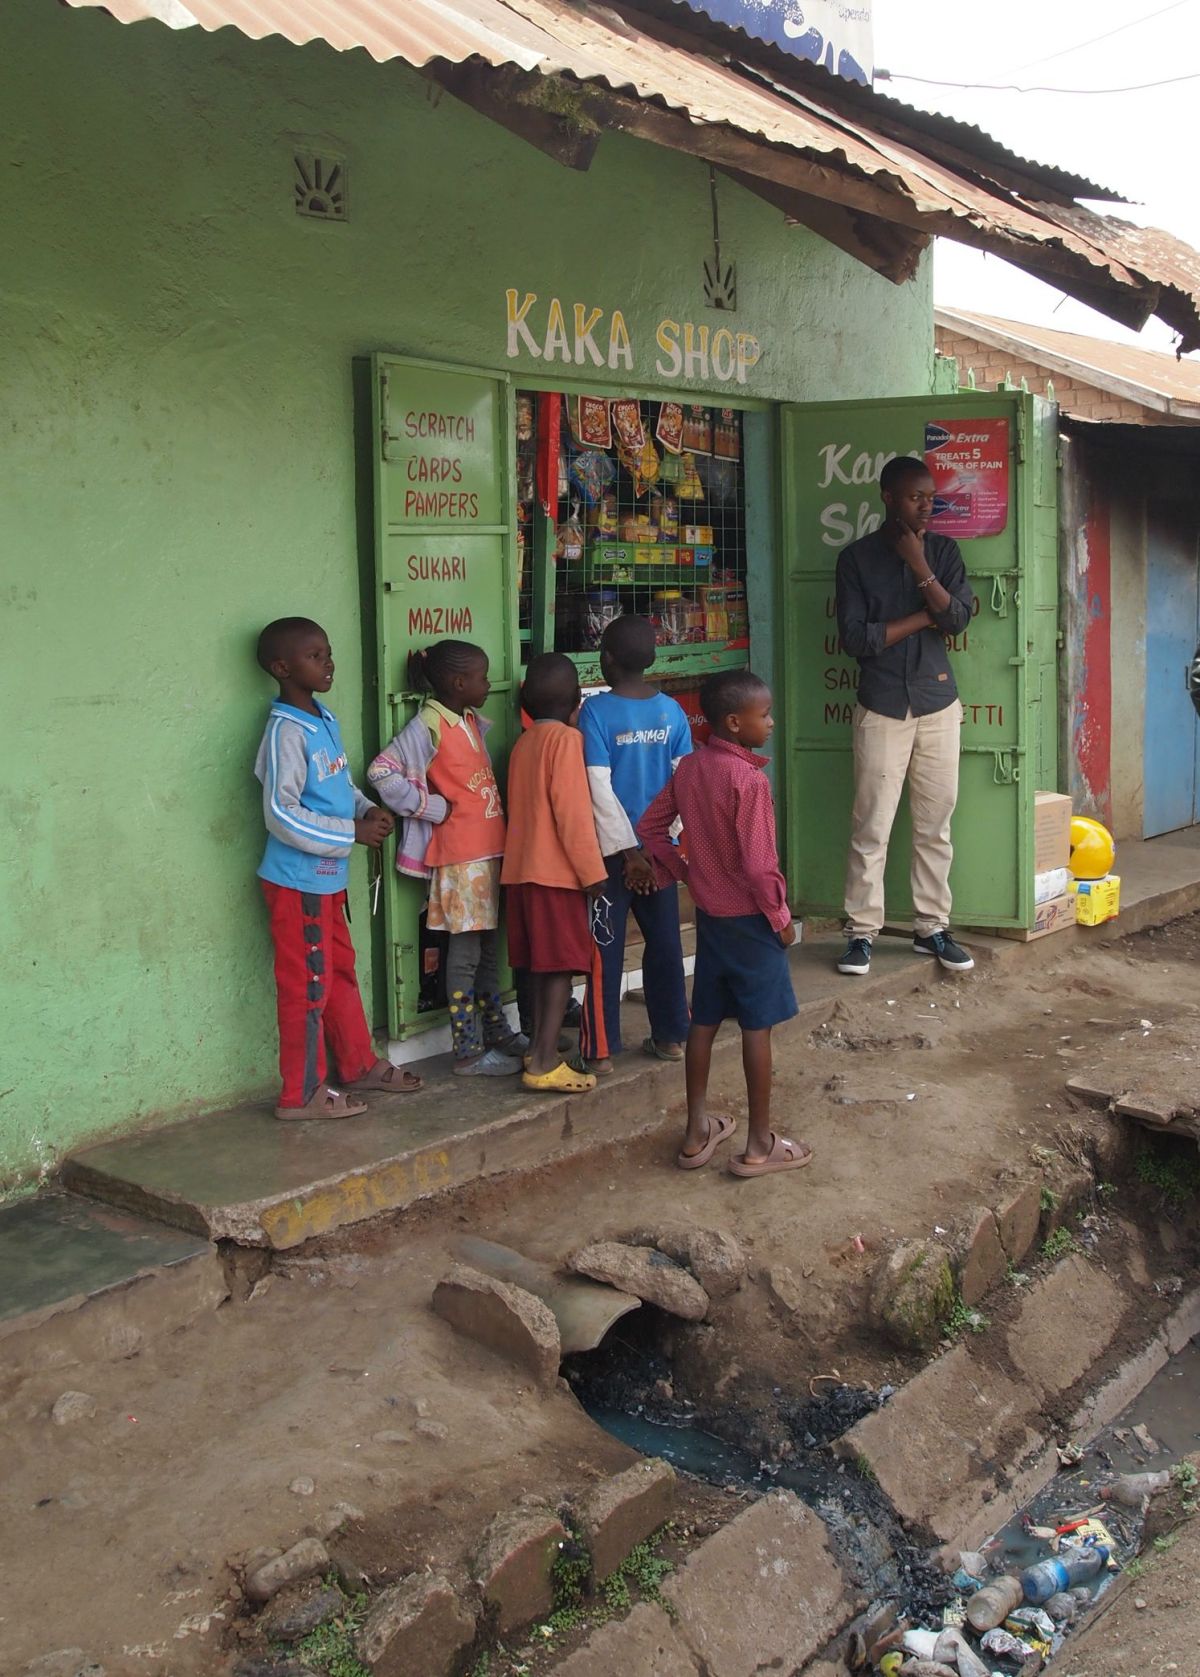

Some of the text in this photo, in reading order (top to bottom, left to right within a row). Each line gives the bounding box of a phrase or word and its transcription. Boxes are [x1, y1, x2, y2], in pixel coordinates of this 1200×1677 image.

[505, 288, 760, 385] KAKA SHOP
[405, 411, 475, 442] SCRATCH
[956, 433, 989, 443] Extra
[935, 448, 982, 460] TREATS 5
[965, 462, 979, 470] OF
[980, 461, 1003, 469] PAIN
[407, 456, 463, 483] CARDS
[405, 490, 479, 518] PAMPERS
[407, 554, 466, 581] SUKARI
[408, 606, 473, 636] MAZIWA
